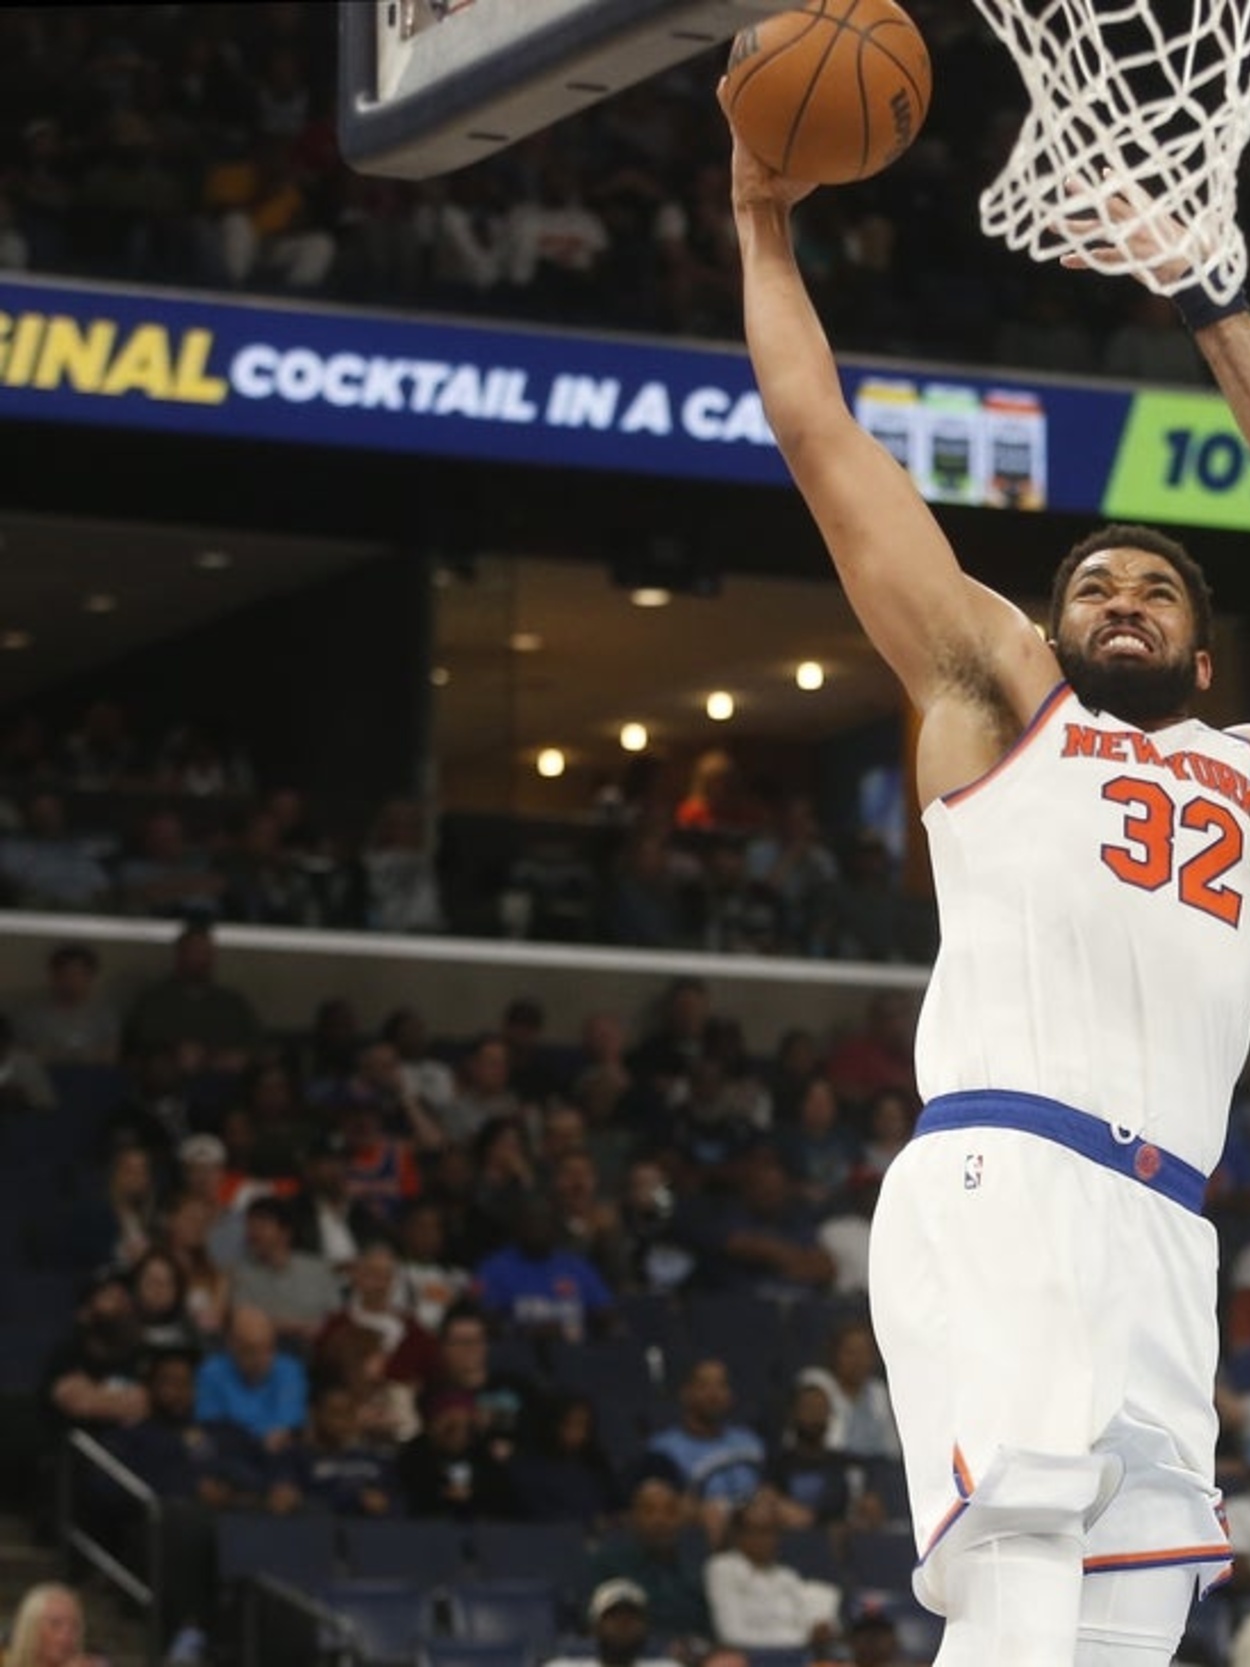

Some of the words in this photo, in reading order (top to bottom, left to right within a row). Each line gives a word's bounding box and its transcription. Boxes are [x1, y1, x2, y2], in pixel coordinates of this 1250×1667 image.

[0, 309, 228, 405] INAL
[230, 343, 537, 424] COCKTAIL
[545, 374, 621, 430] IN
[622, 382, 673, 436] A
[681, 386, 779, 446] CA
[1060, 722, 1167, 769] NEW
[1100, 775, 1243, 930] 32
